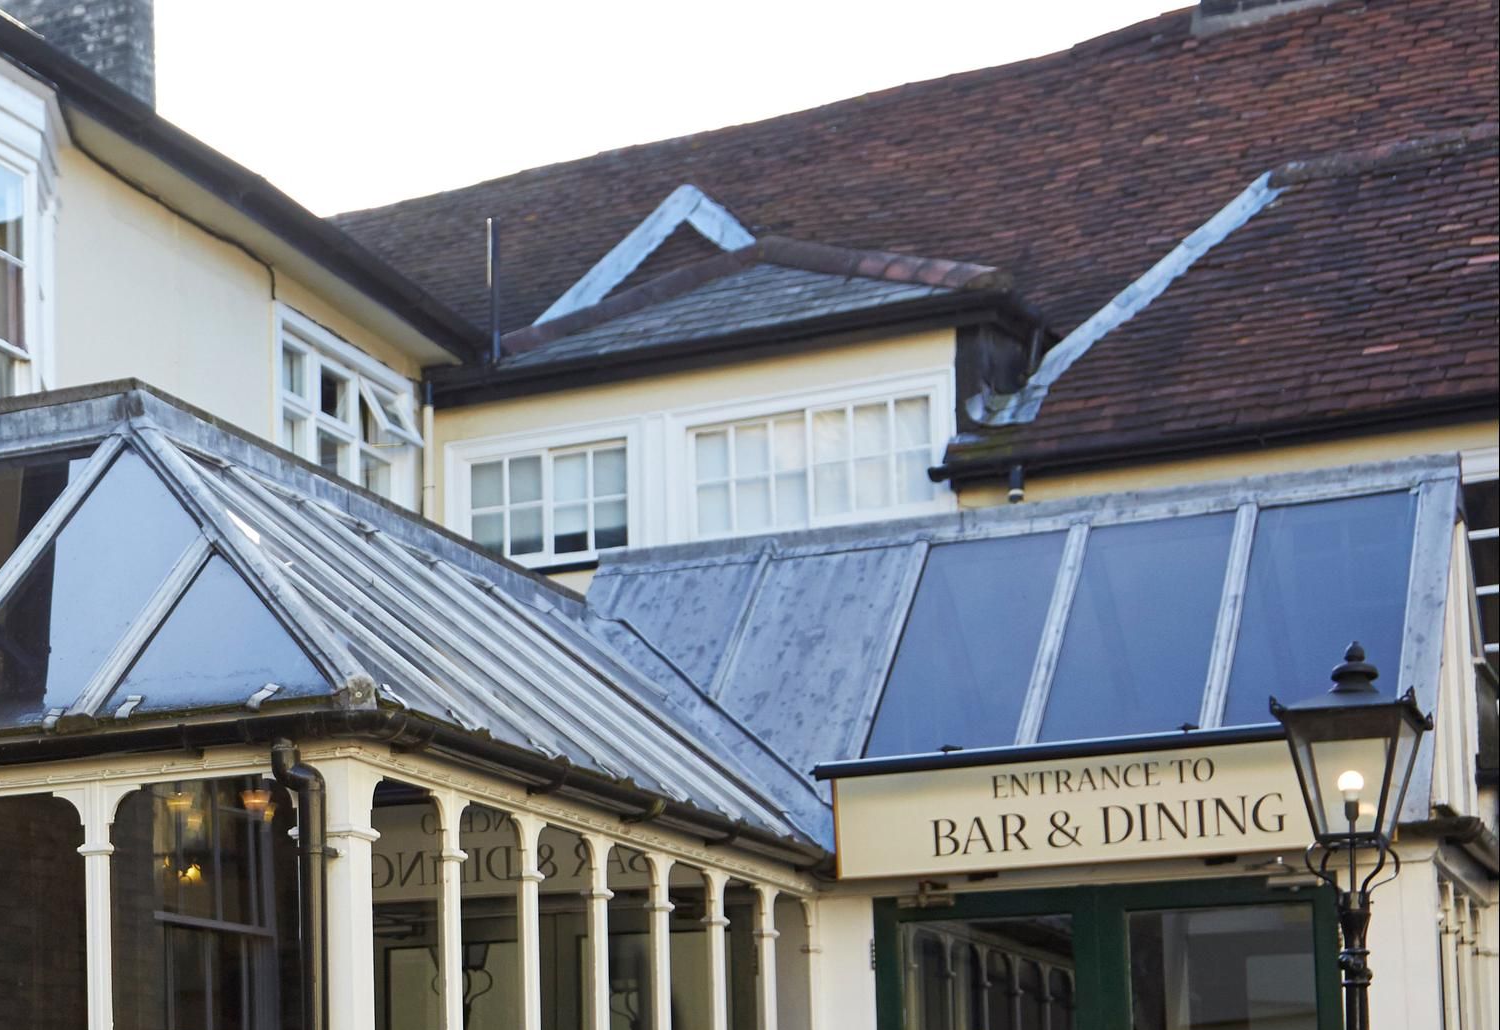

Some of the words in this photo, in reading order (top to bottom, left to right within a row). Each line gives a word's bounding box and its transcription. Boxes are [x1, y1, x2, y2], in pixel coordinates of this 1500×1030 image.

[992, 761, 1161, 799] ENTRANCE
[1169, 756, 1216, 785] TO
[932, 812, 1032, 857] BAR
[1047, 809, 1083, 849] &
[1100, 792, 1288, 845] DINING
